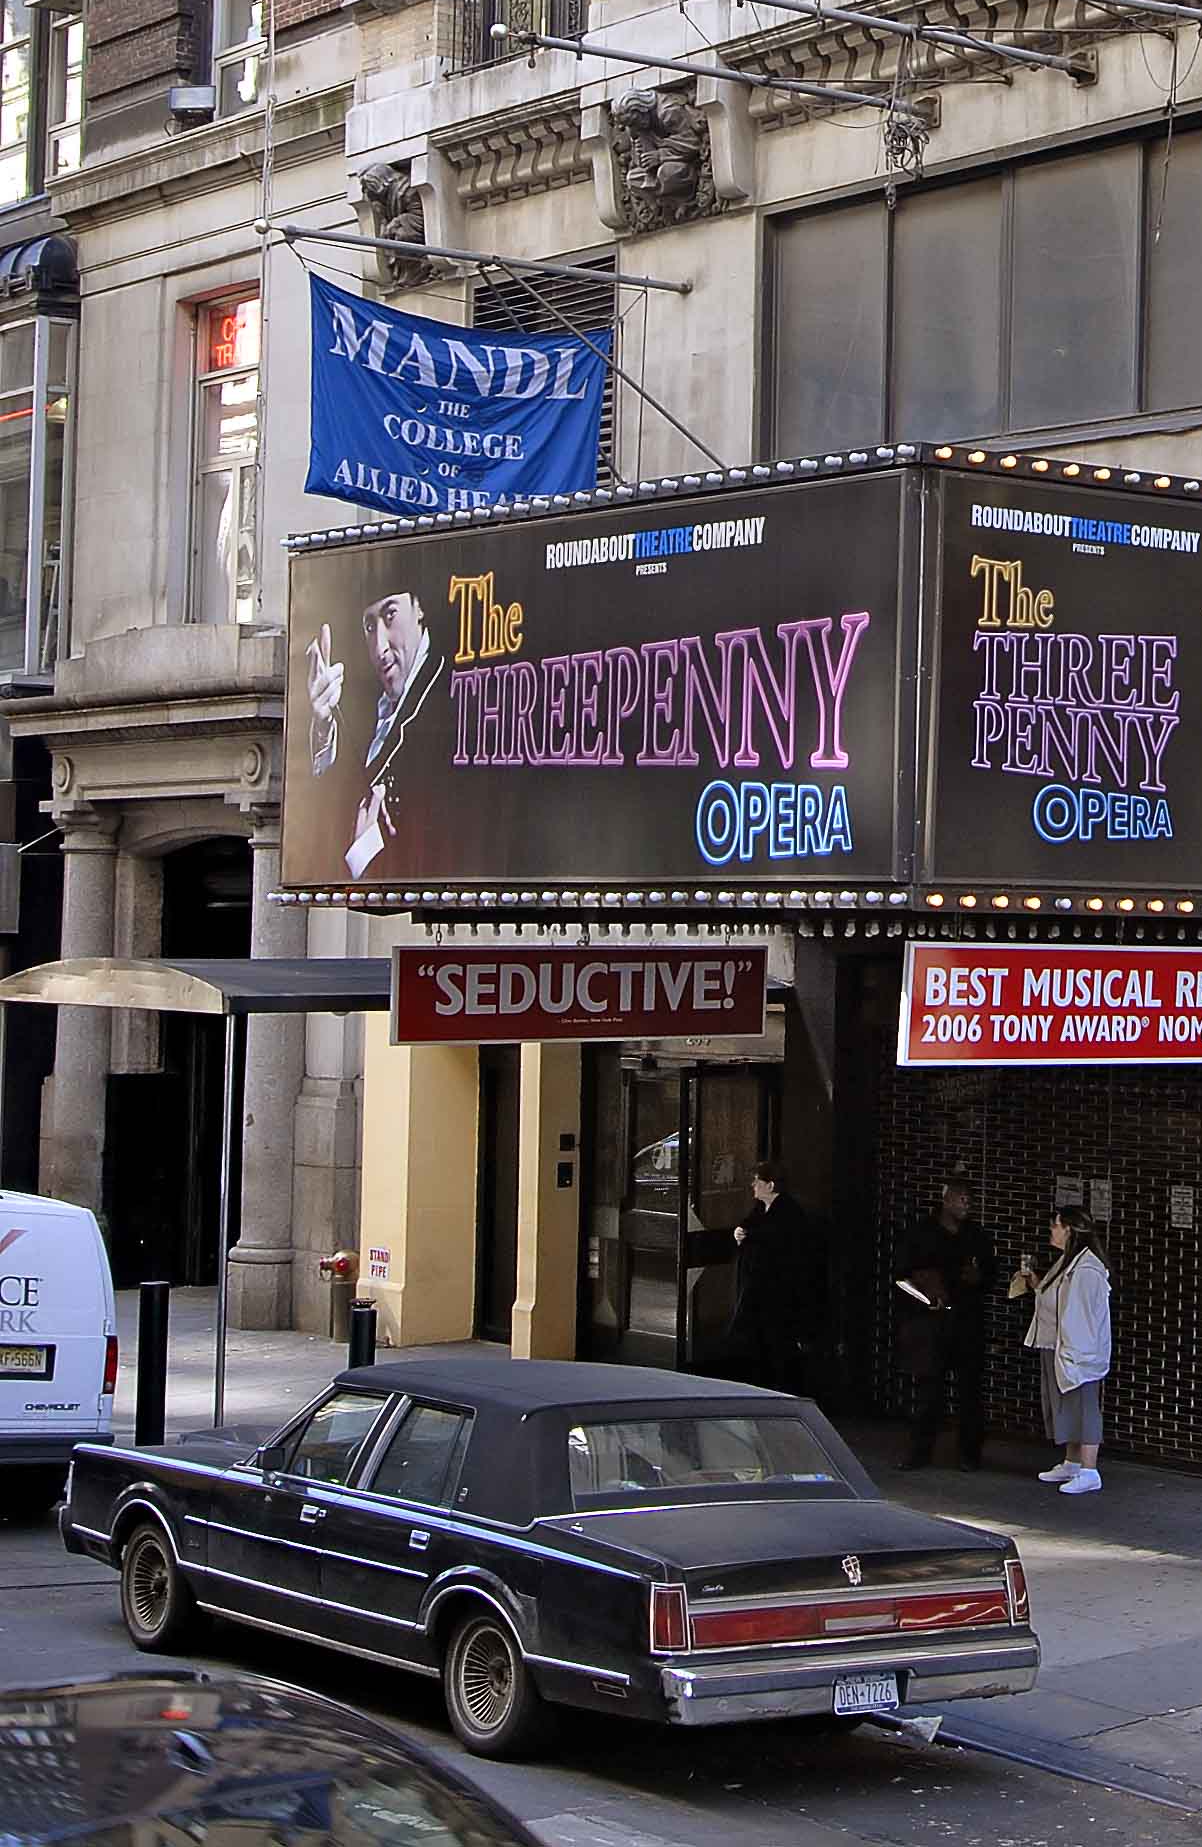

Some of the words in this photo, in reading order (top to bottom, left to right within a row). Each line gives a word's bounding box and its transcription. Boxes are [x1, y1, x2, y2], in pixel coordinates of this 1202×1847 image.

[328, 299, 590, 400] MANDL
[437, 400, 470, 419] THE
[384, 414, 524, 460] COLLEGE
[334, 459, 440, 508] ALLIED
[438, 462, 461, 478] OF
[635, 562, 667, 576] PRESENTS
[1073, 543, 1104, 555] PRESENTS
[970, 555, 1055, 628] The
[449, 570, 523, 664] The
[450, 611, 871, 771] THREEPENNY
[972, 631, 1180, 713] THREE
[970, 701, 1180, 793] PENNY
[696, 779, 853, 867] OPERA
[1033, 783, 1173, 844] OPERA
[924, 967, 1008, 1007] BEST
[1022, 968, 1162, 1008] MUSICAL
[921, 1014, 983, 1042] 2006
[990, 1014, 1054, 1042] TONY
[371, 1264, 386, 1278] PIPE
[25, 1403, 80, 1411] CHEVROLET
